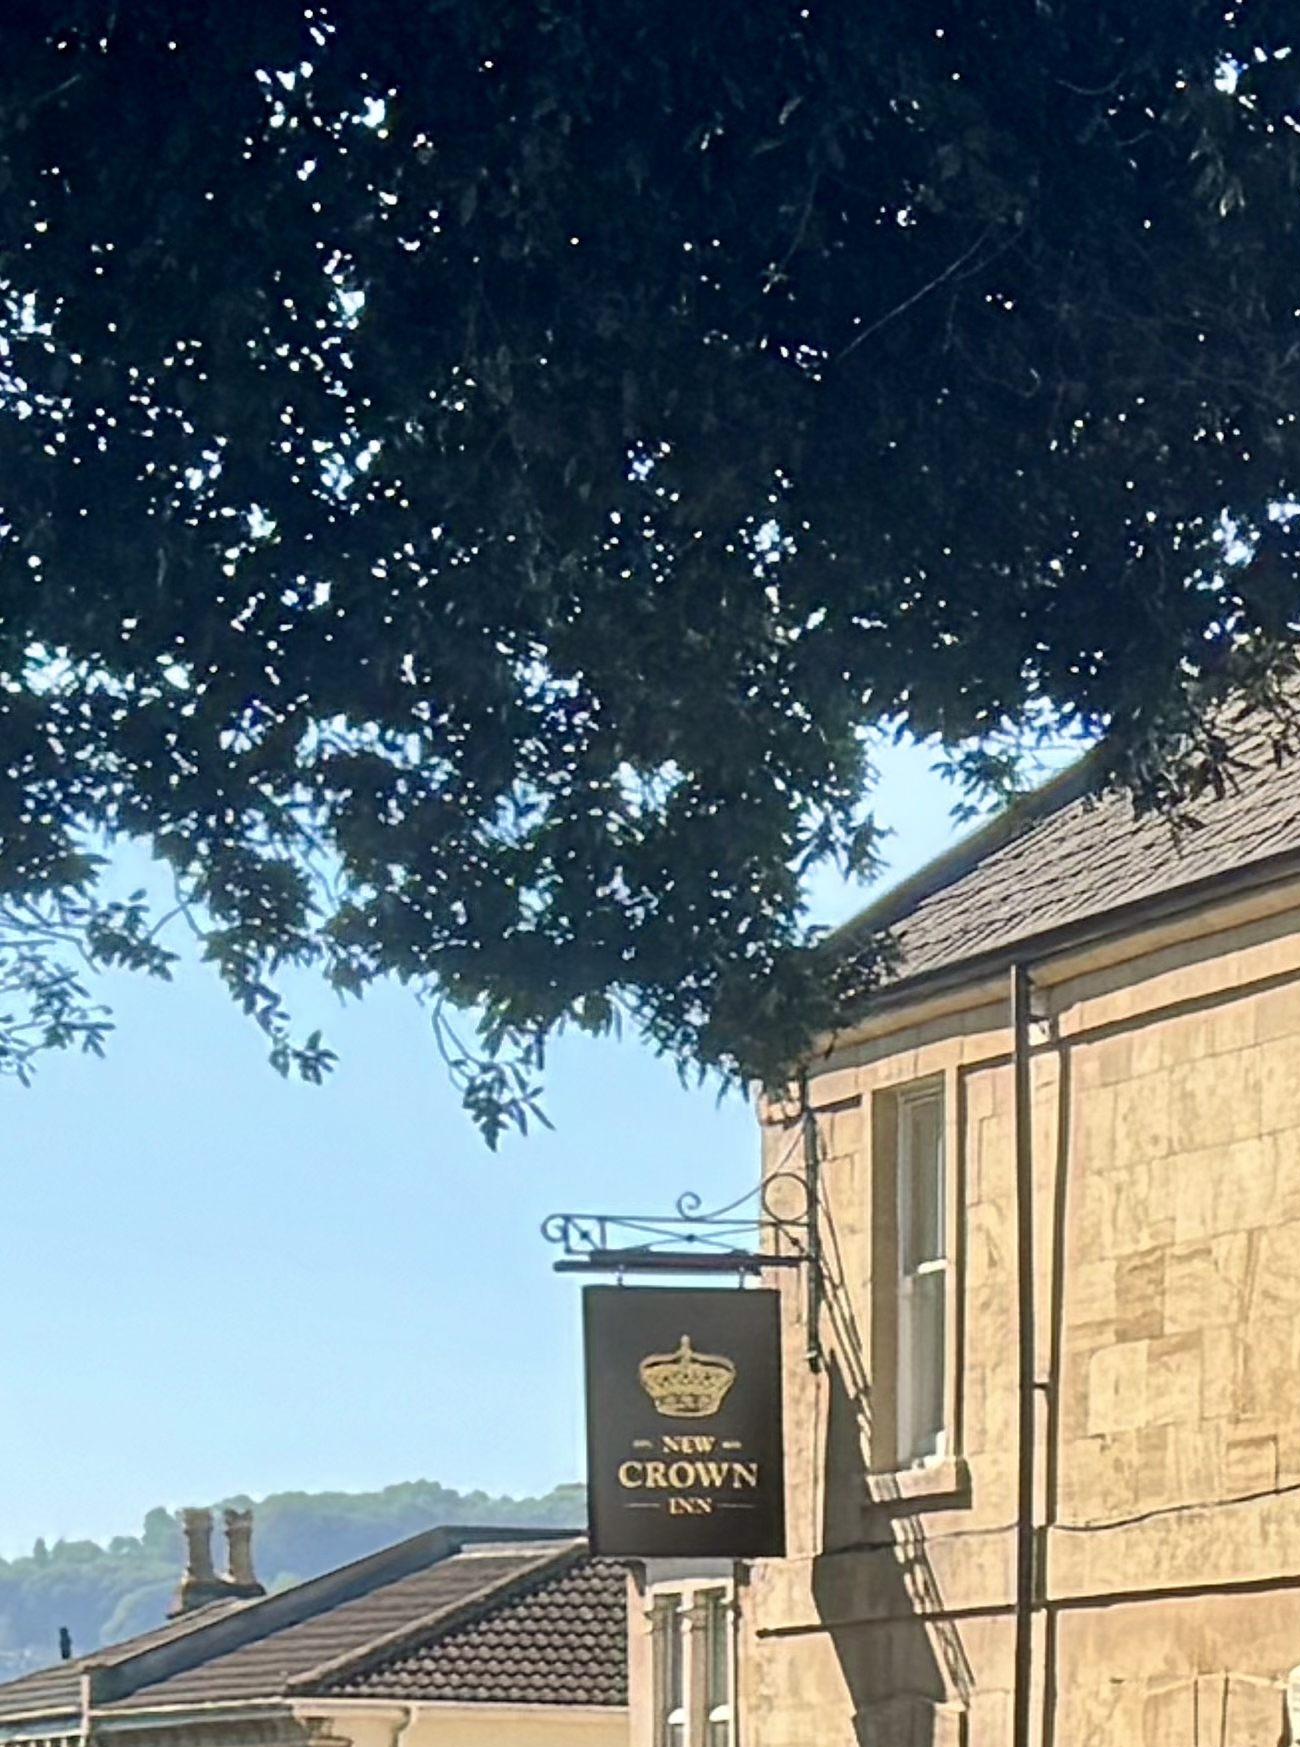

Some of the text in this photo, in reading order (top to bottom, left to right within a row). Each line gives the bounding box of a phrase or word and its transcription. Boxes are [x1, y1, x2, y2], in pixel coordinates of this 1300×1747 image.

[662, 1436, 715, 1453] NEW
[619, 1461, 757, 1488] CROWN
[670, 1497, 711, 1514] INN
